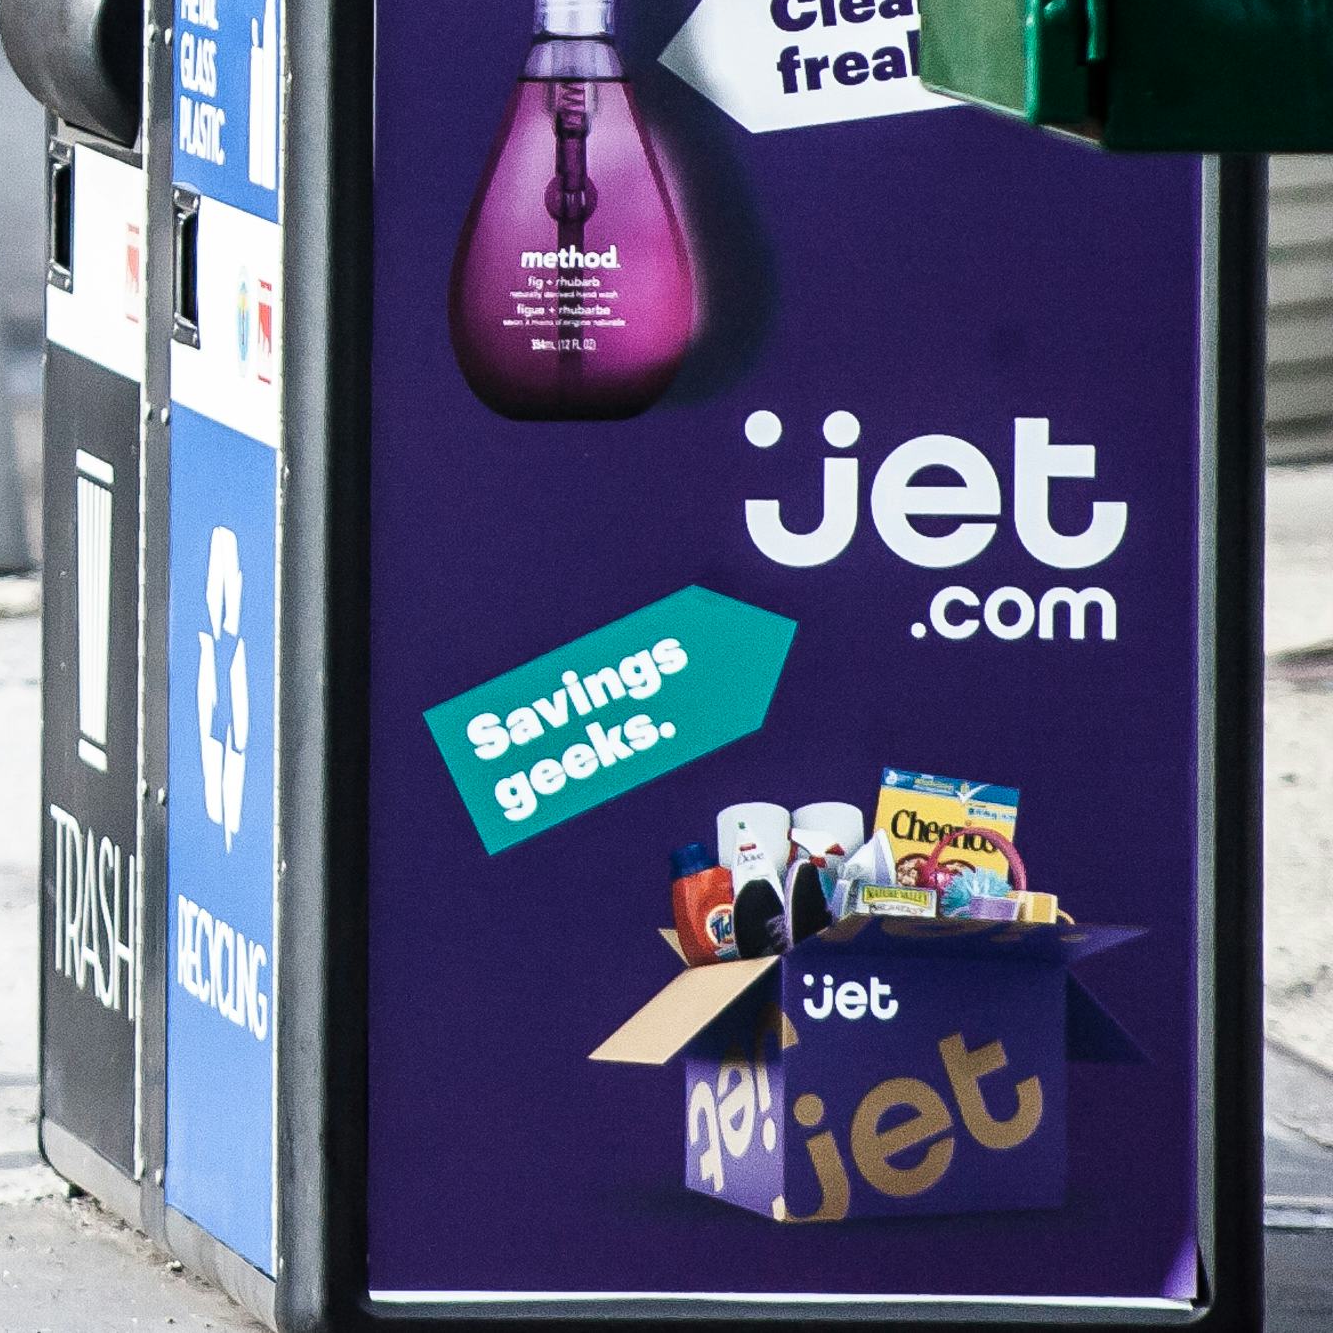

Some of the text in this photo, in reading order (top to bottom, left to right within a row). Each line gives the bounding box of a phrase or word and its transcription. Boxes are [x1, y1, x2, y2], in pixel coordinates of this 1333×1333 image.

[180, 32, 217, 98] GLASS
[179, 95, 226, 166] PLASTIC
[516, 304, 545, 317] figue
[558, 304, 611, 315] rhubarbe
[527, 276, 543, 289] fig
[555, 276, 601, 287] rhubarb
[744, 410, 1128, 569] jet
[911, 586, 1117, 641] .com
[466, 637, 688, 760] Savings
[494, 713, 677, 822] geeks.
[50, 803, 135, 1021] TRASH
[710, 913, 732, 944] Tid
[177, 894, 268, 1042] RECYCLING
[803, 973, 899, 1021] jet
[773, 1032, 1043, 1223] jet
